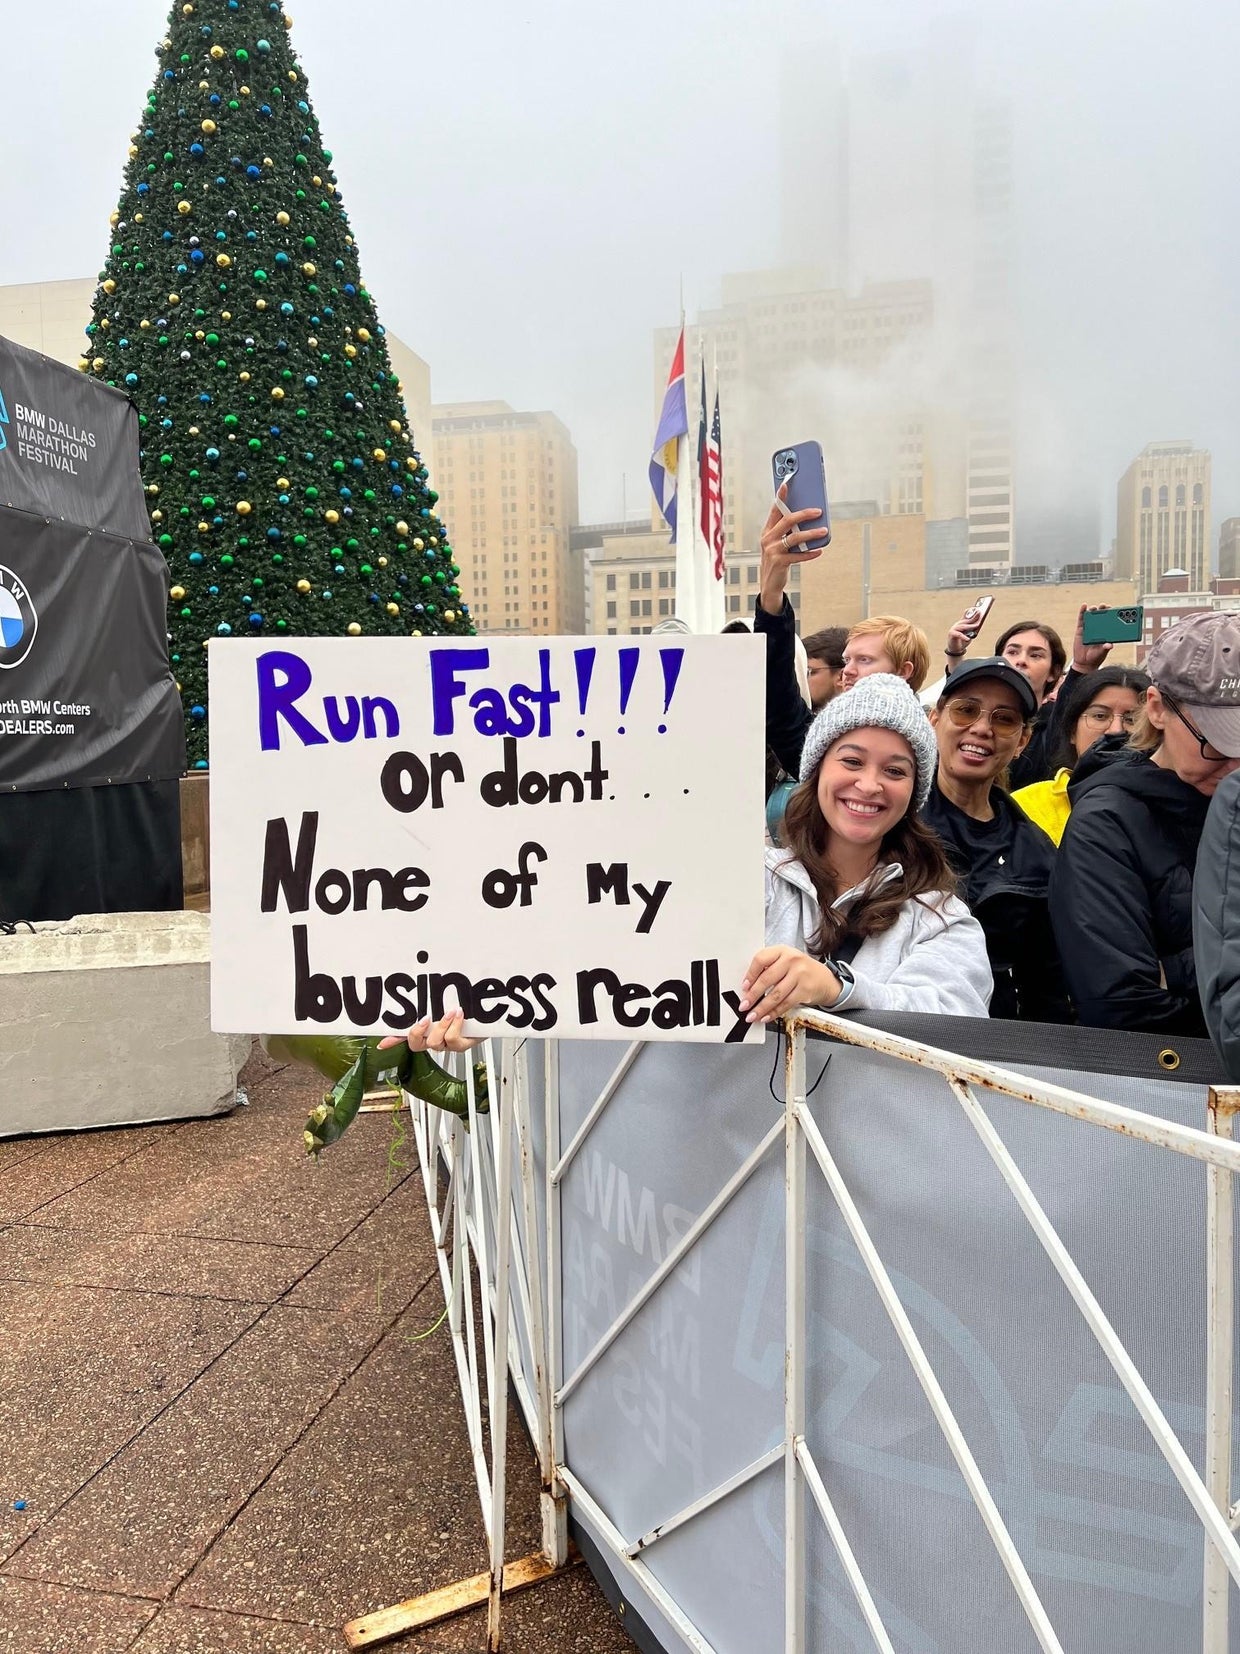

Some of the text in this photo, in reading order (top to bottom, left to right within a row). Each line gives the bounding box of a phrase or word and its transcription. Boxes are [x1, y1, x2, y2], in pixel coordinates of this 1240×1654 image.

[15, 403, 96, 448] BMW DALLAS
[16, 422, 88, 462] MARATHON
[18, 441, 78, 475] FESTIVAL
[20, 700, 51, 715] BMW
[53, 700, 91, 716] Centers
[256, 650, 399, 751] Run
[380, 750, 464, 813] or
[261, 811, 672, 934] None of My
[292, 924, 764, 1043] business really
